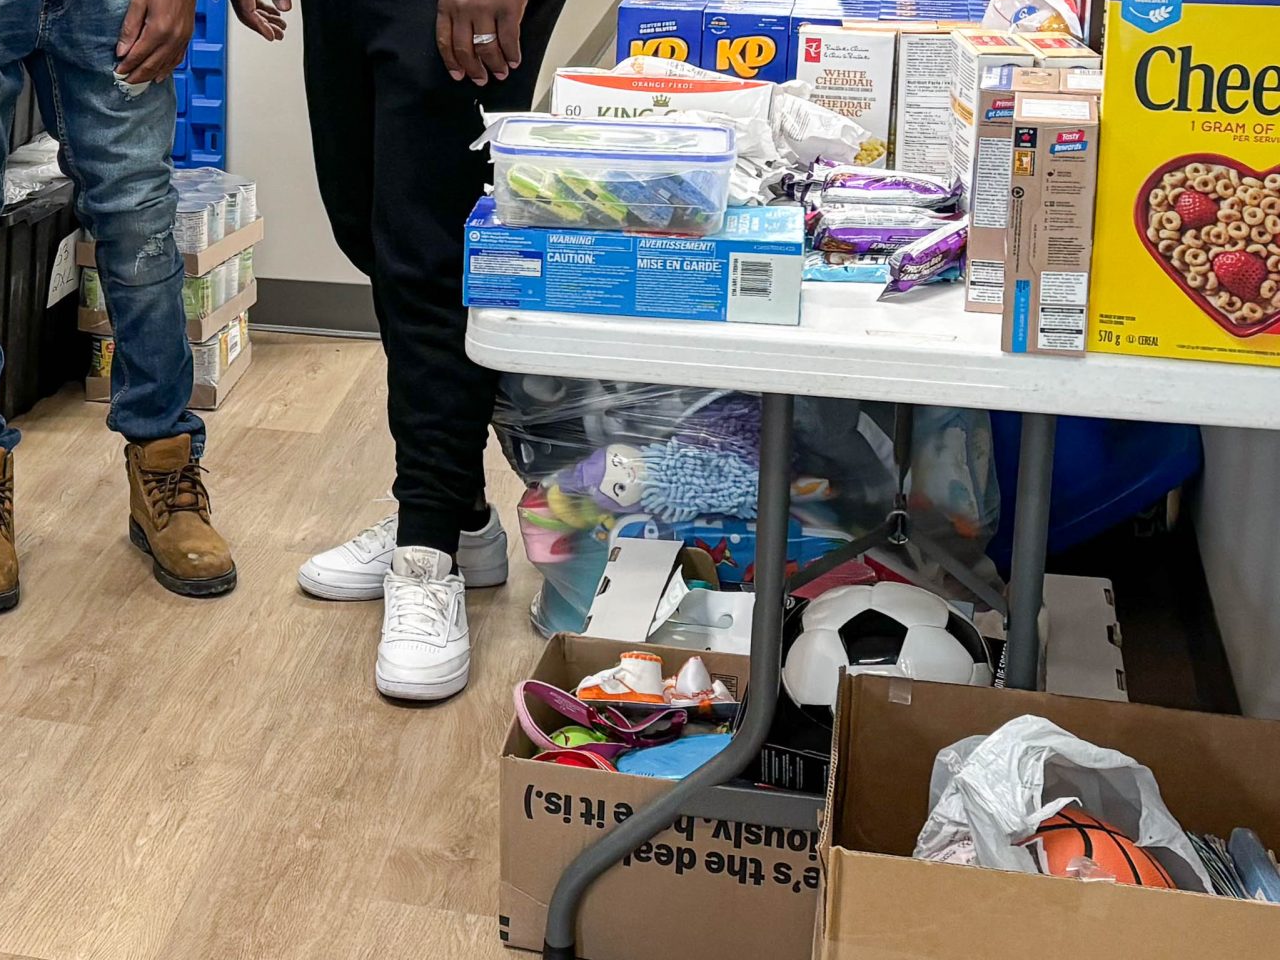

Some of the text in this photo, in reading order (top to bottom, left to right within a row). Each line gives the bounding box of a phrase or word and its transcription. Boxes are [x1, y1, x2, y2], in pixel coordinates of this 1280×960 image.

[823, 69, 867, 79] WHITE
[1134, 44, 1280, 116] Chee
[815, 76, 873, 87] CHEDDAR
[565, 105, 582, 117] 60
[1191, 120, 1276, 135] 1 GRAM OF
[548, 234, 596, 246] WARNING!
[638, 239, 716, 252] AVERTISSEMENT!
[547, 252, 596, 265] CAUTION:
[637, 258, 664, 270] MISE
[665, 259, 681, 271] EN
[683, 260, 722, 272] GARDE:
[1098, 330, 1159, 347] 570 g CEREAL
[523, 784, 573, 824] is.)
[581, 797, 606, 829] it
[705, 851, 766, 887] the
